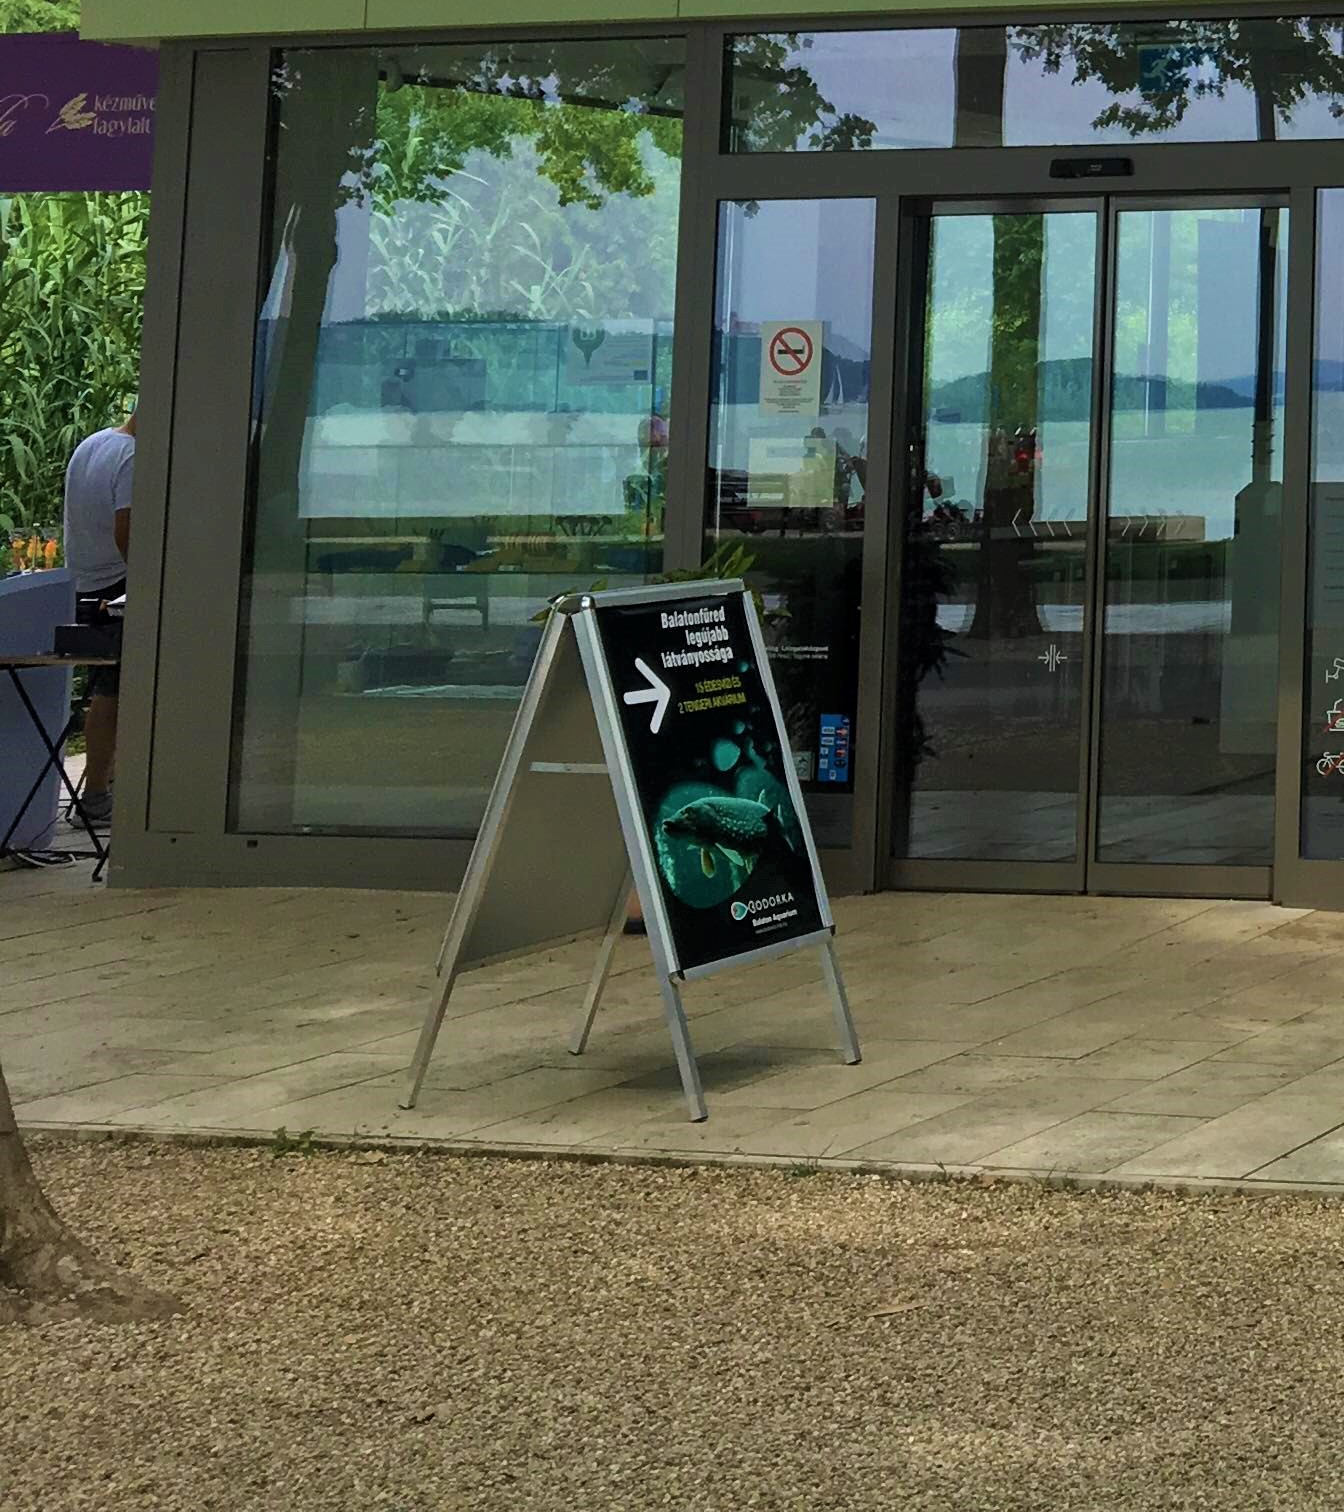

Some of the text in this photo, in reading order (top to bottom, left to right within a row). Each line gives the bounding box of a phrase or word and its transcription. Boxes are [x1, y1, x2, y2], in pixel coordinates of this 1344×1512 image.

[660, 605, 726, 629] Balatonfüred
[685, 624, 729, 648] legújabb
[661, 644, 734, 668] látványossága
[678, 702, 685, 714] 2
[748, 892, 795, 914] BODORKA
